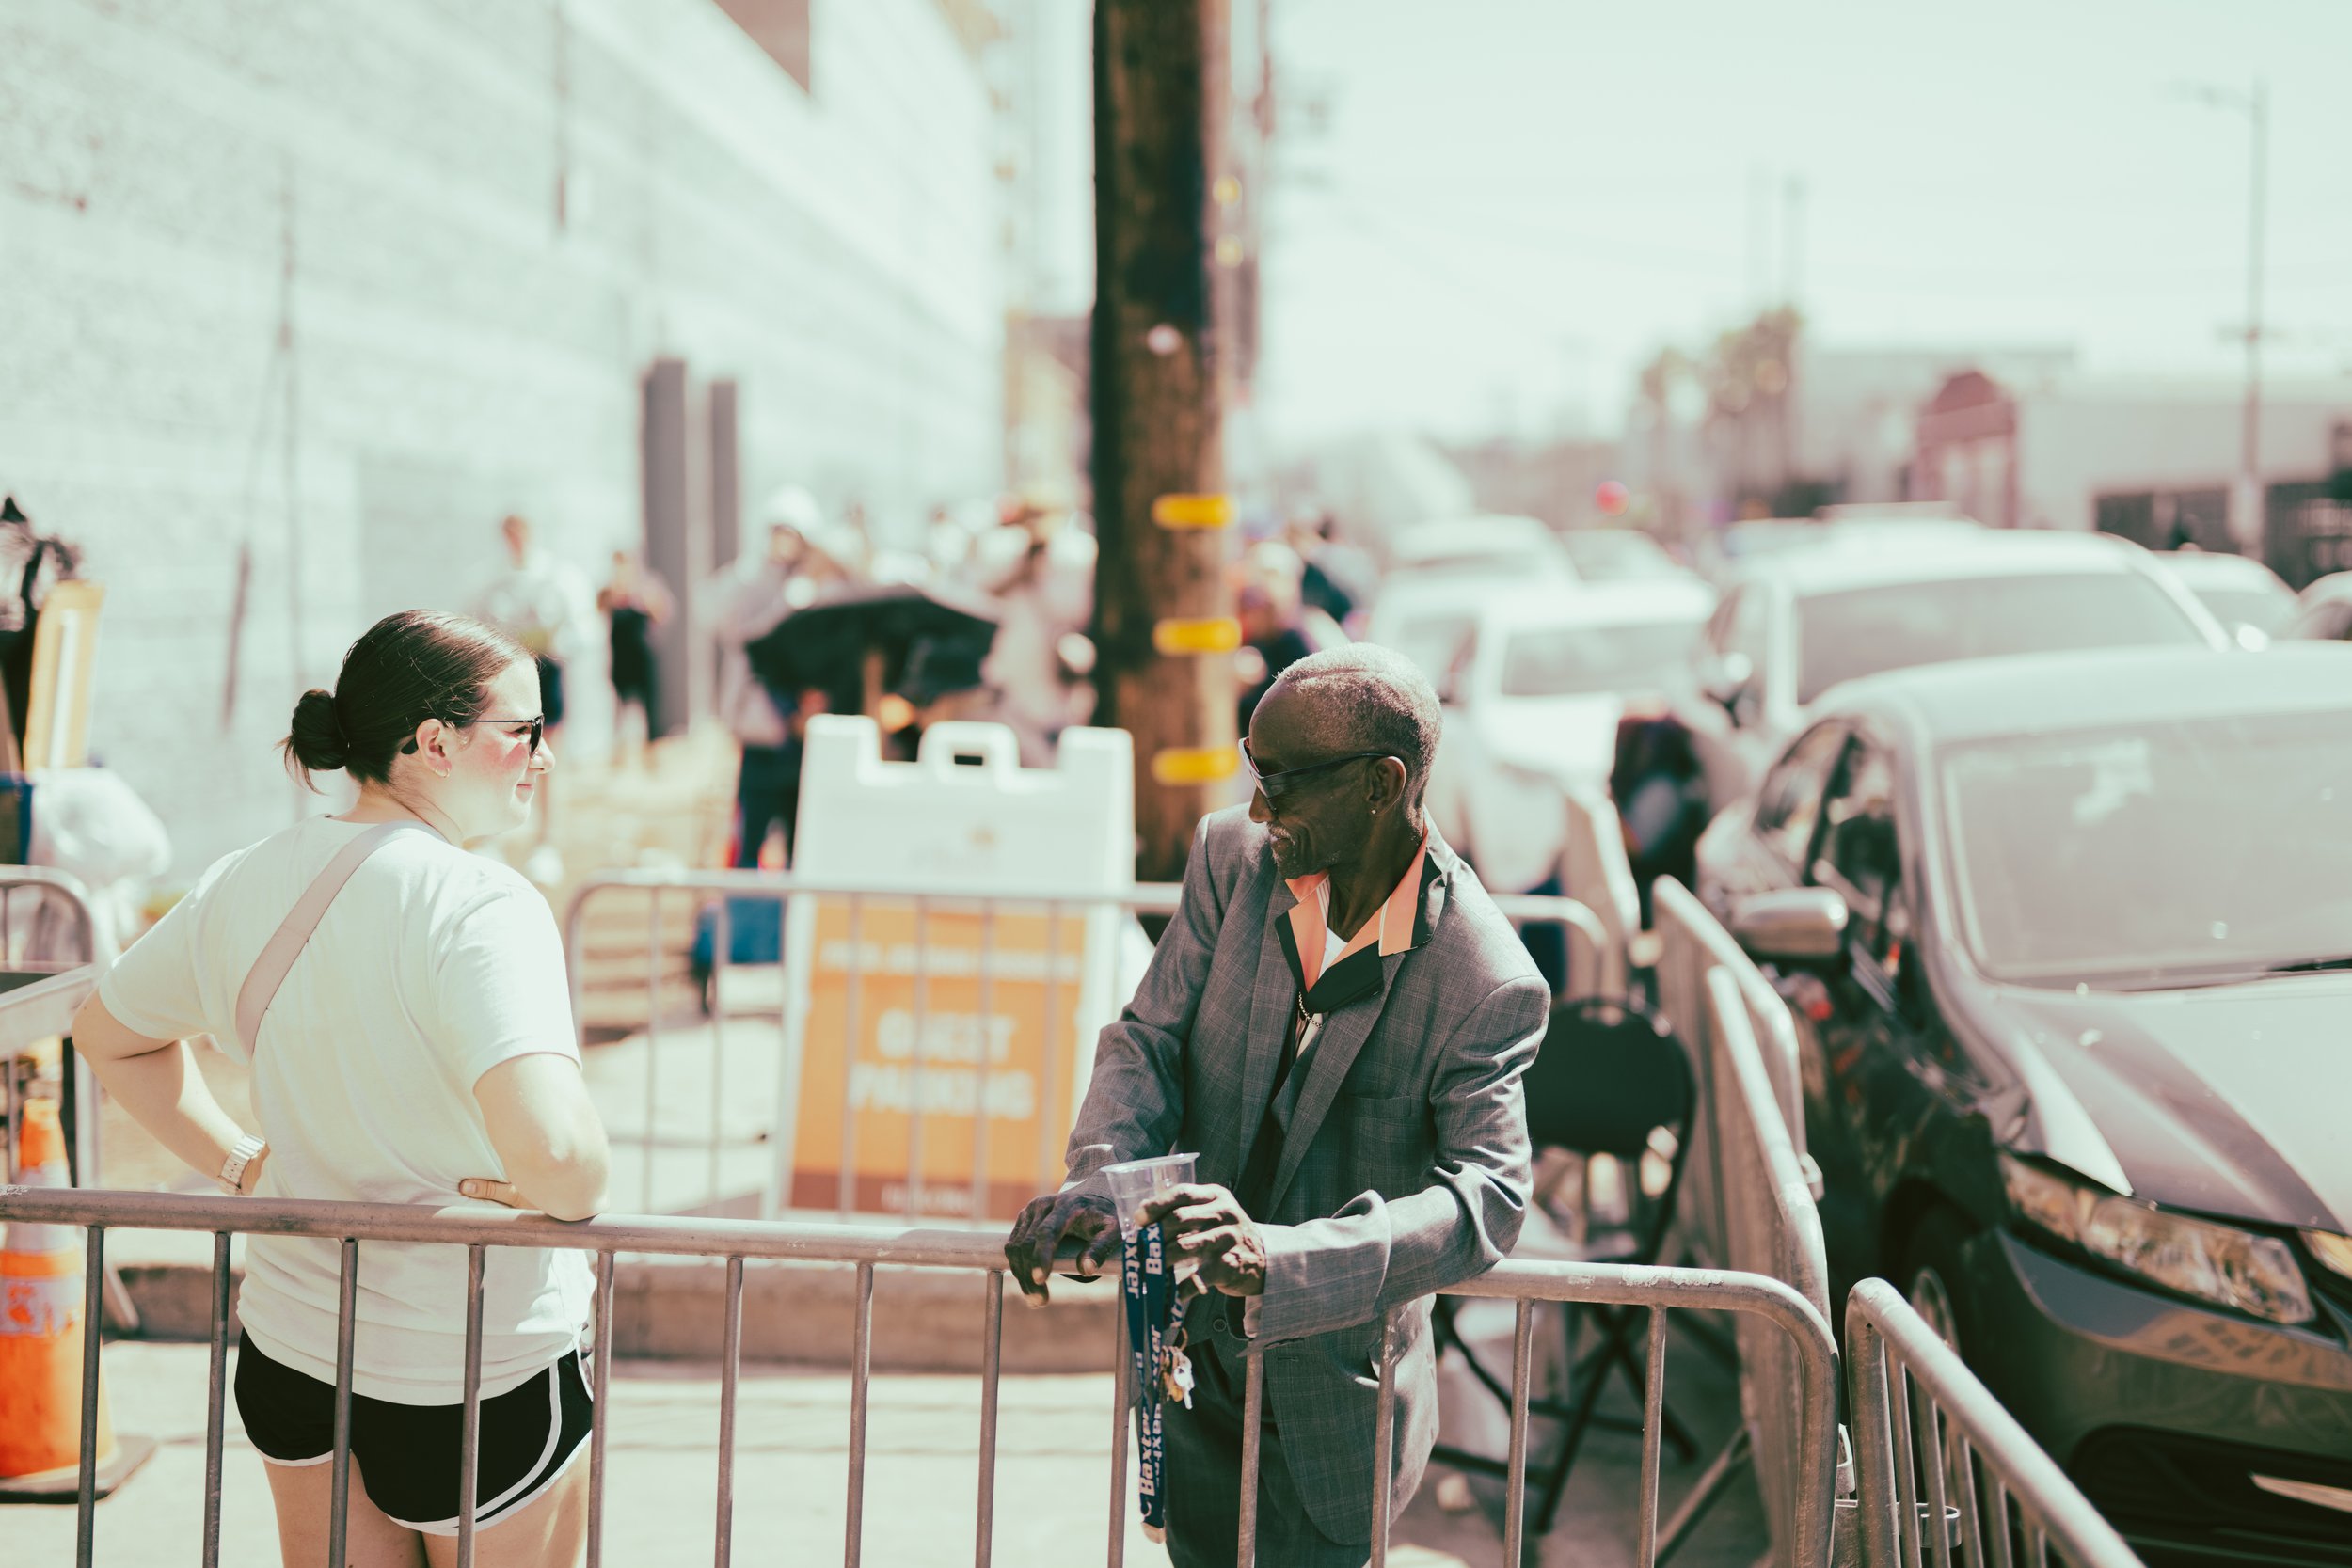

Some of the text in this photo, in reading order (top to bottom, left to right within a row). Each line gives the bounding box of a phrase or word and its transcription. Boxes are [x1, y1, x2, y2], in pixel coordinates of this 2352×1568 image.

[1124, 1230, 1140, 1299] axter
[1146, 1222, 1162, 1275] Bax
[1140, 1406, 1156, 1497] Baxter
